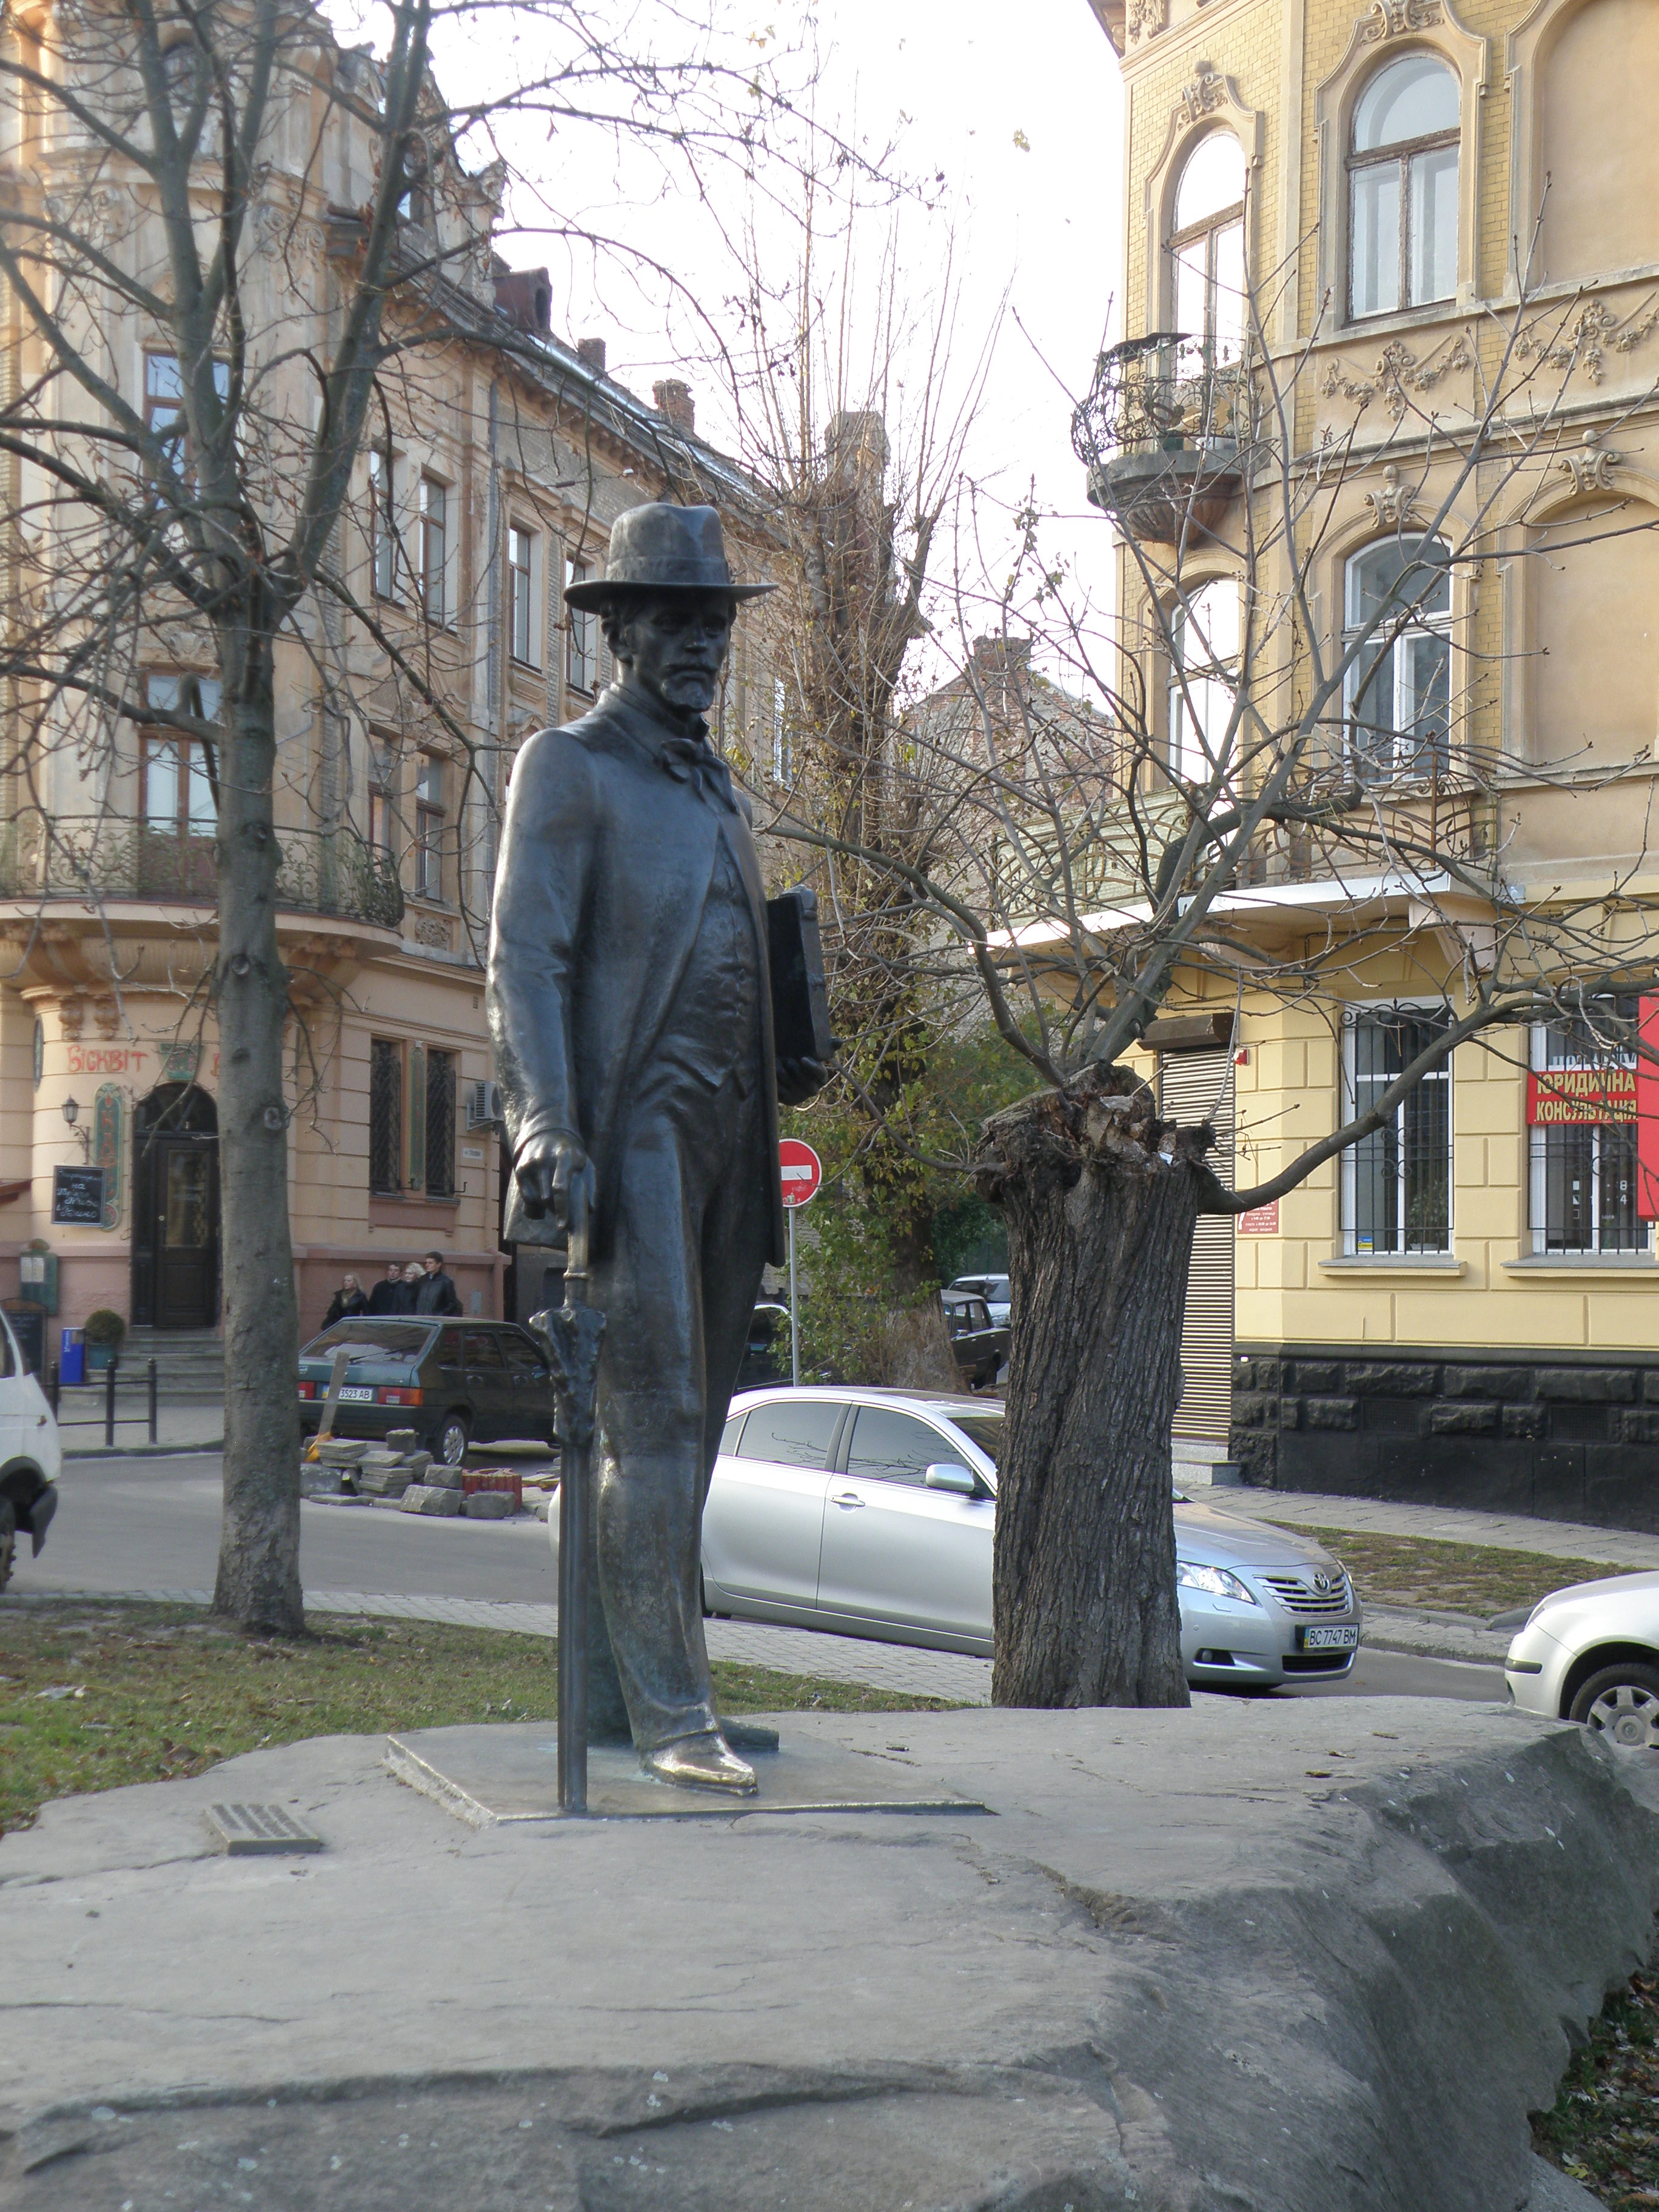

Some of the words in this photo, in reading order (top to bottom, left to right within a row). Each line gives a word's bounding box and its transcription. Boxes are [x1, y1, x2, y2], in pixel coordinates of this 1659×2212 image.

[1537, 1071, 1636, 1097] ЮРИДИЧНА
[340, 1389, 358, 1398] 3523
[359, 1390, 369, 1399] AB
[1310, 1630, 1322, 1645] BC
[1324, 1629, 1342, 1644] 7747
[1344, 1629, 1356, 1644] BM
